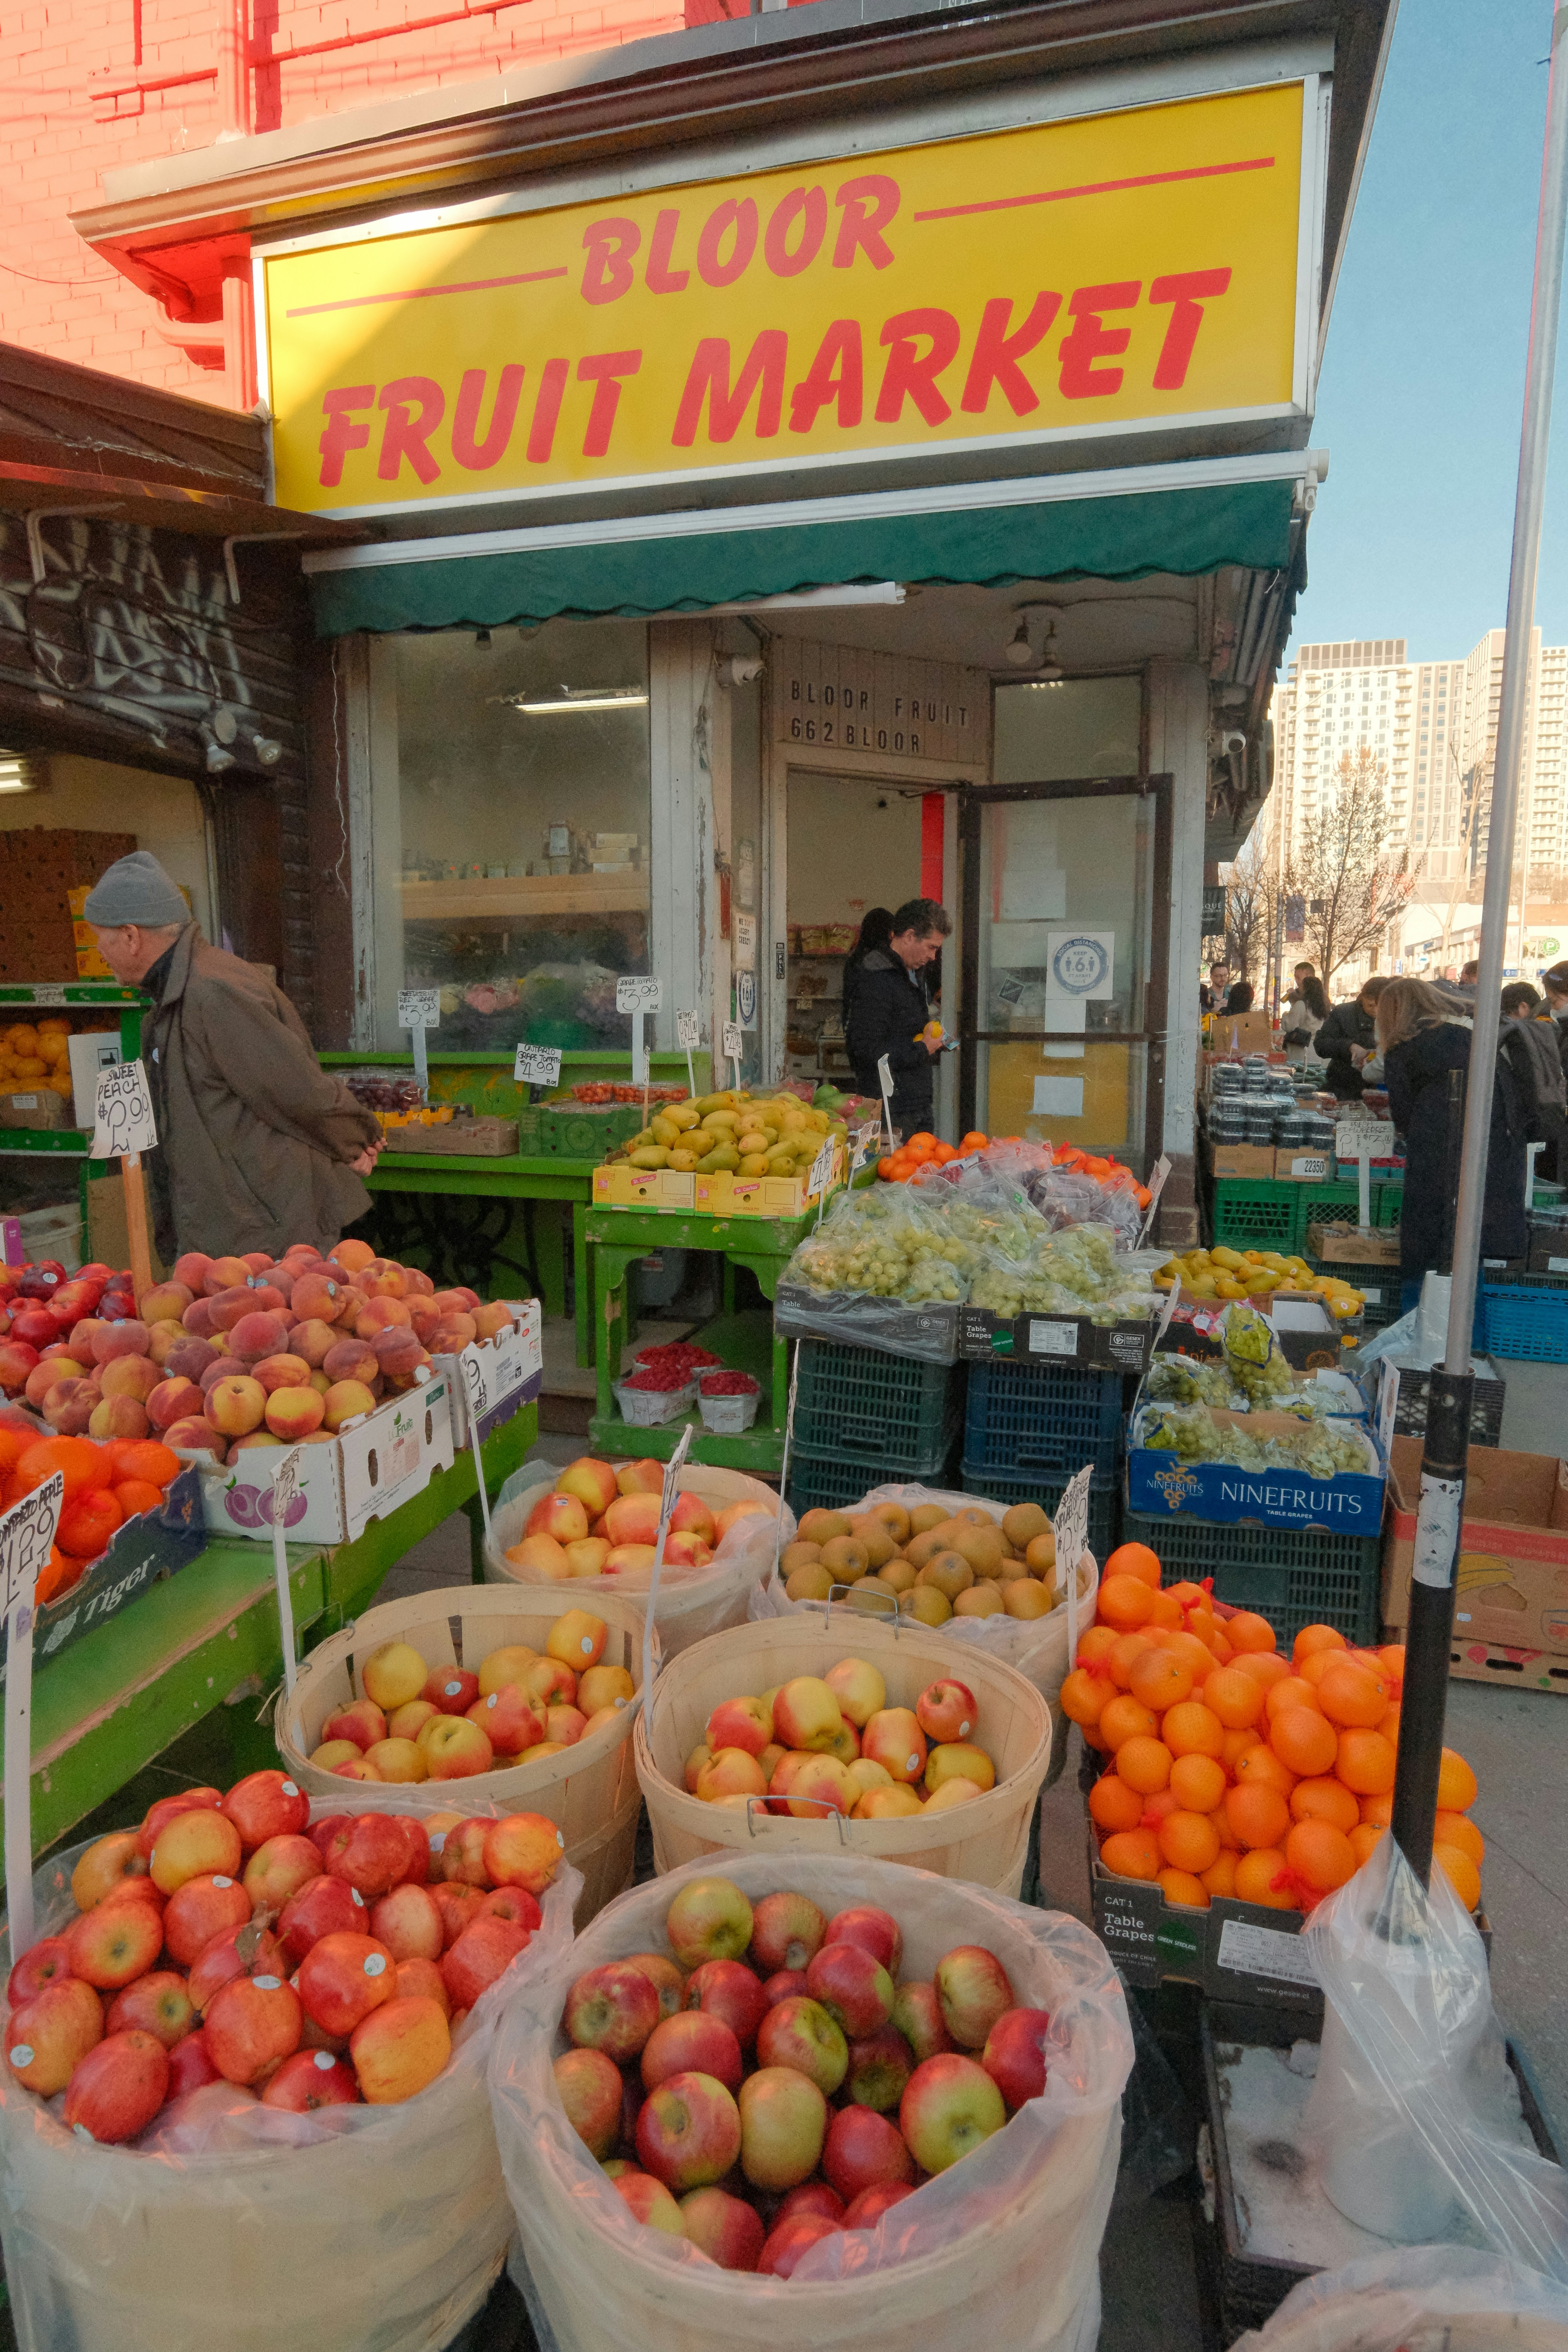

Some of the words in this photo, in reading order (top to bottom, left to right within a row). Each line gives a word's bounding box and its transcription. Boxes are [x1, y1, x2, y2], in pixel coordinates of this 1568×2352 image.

[579, 174, 901, 305] BLOOR
[319, 348, 642, 487] FRUIT
[671, 266, 1232, 446] MARKET
[792, 680, 868, 710] BLOOR
[895, 698, 967, 726] FRUIT
[791, 718, 833, 743] 662
[847, 725, 919, 752] BLOOR
[1057, 943, 1073, 956] SOCIAL
[1074, 940, 1103, 956] DISTANCING
[1075, 957, 1085, 972] 6
[518, 1051, 537, 1061] GRAPE
[539, 1054, 561, 1063] TOMATO
[107, 1064, 138, 1082] SWEET
[98, 1078, 141, 1101] PEACH
[1305, 1160, 1324, 1173] 22350
[1146, 1479, 1204, 1494] NINEFRUITS
[1221, 1482, 1362, 1514] NINEFRUITS
[83, 1554, 155, 1624] Tiger
[1105, 1897, 1125, 1906] CAT
[1104, 1913, 1144, 1929] Table
[1104, 1925, 1155, 1942] Grapes
[1157, 1936, 1173, 1944] GREEN
[1174, 1941, 1197, 1951] SEEDLESS
[1257, 1986, 1310, 1999] www.gesex.cl
